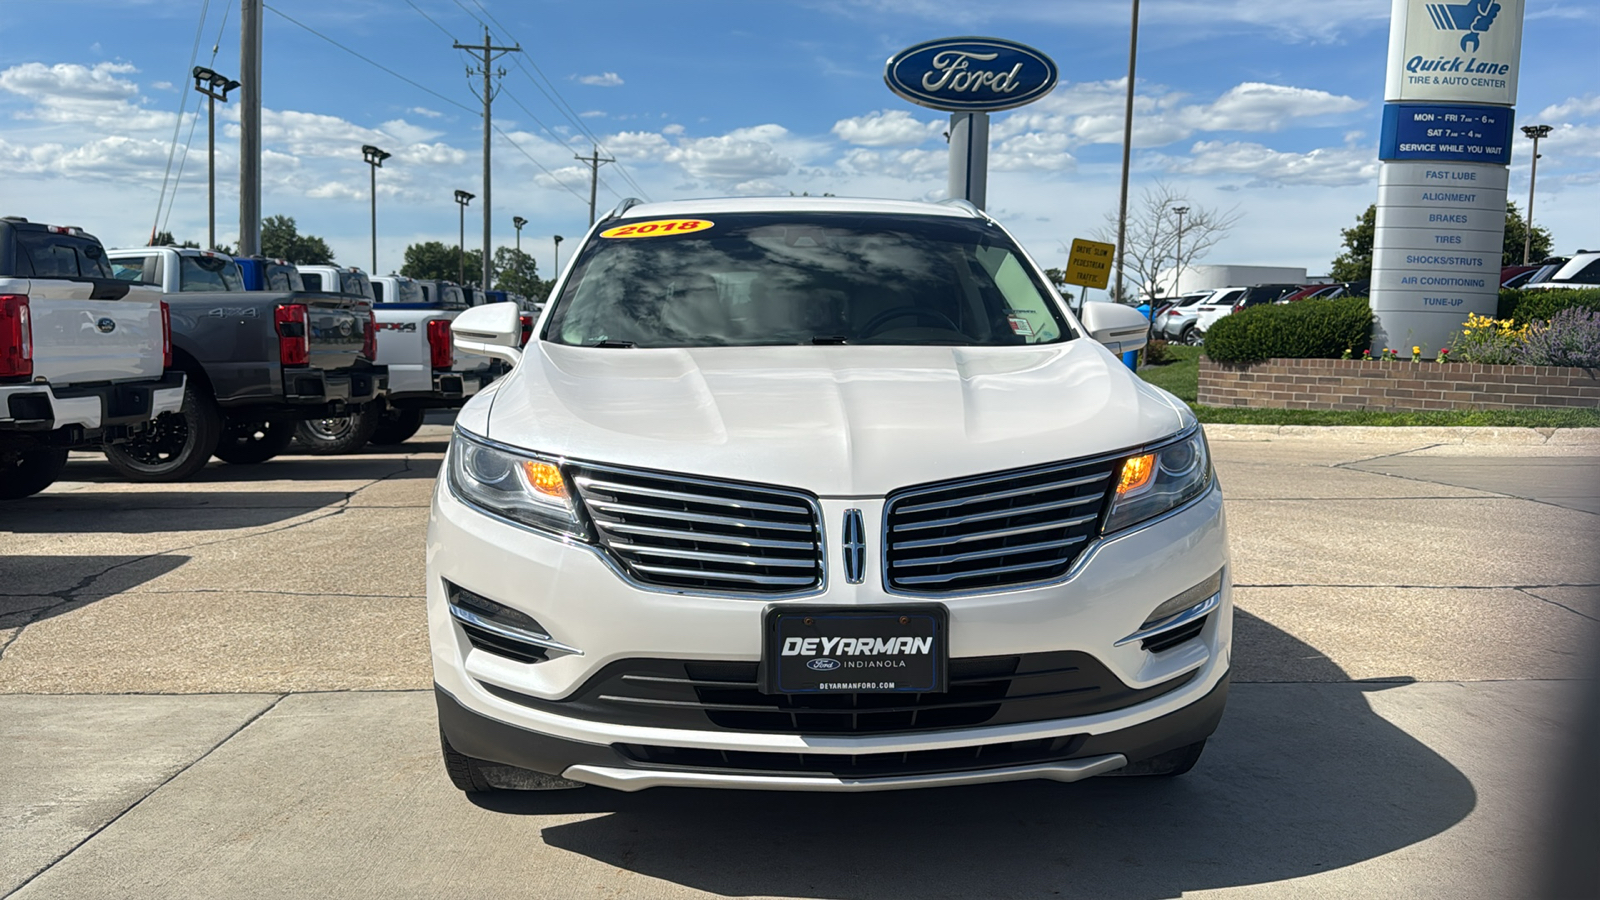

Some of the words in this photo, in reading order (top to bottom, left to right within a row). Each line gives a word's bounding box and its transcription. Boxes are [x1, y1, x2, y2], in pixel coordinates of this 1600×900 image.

[1406, 55, 1464, 74] Quick
[1464, 57, 1510, 75] Lane
[921, 50, 1024, 94] Ford
[1408, 76, 1431, 85] TIRE
[1432, 76, 1440, 85] &
[1442, 77, 1469, 86] AUTO
[1471, 78, 1506, 88] CENTER
[1414, 113, 1434, 122] MON
[1445, 114, 1458, 122] FRI
[1427, 129, 1443, 137] SAT
[1400, 143, 1436, 152] SERVICE
[1439, 144, 1464, 153] WHILE
[1467, 145, 1483, 154] YOU
[1485, 146, 1502, 155] WAIT
[1425, 170, 1450, 180] FAST
[1452, 171, 1476, 181] LUBE
[1422, 192, 1476, 203] ALIGNMENT
[1429, 214, 1468, 224] BRAKES
[612, 221, 702, 237] 2018
[1435, 235, 1462, 245] TIRES
[1076, 245, 1092, 255] DRIVE
[1094, 248, 1108, 257] SLOW
[1073, 258, 1105, 270] PEDESTRIAN
[1406, 255, 1483, 267] SHOCKS/STRUTS
[1076, 272, 1099, 282] TRAFFIC
[1401, 276, 1418, 285] AIR
[1420, 277, 1485, 288] CONDITIONING
[1423, 297, 1464, 307] TUNE-UP
[781, 636, 933, 656] DEYARMAN
[813, 660, 834, 669] Ford
[843, 660, 906, 668] INDIANOLA
[819, 682, 895, 690] DEYARMANFORD.COM
